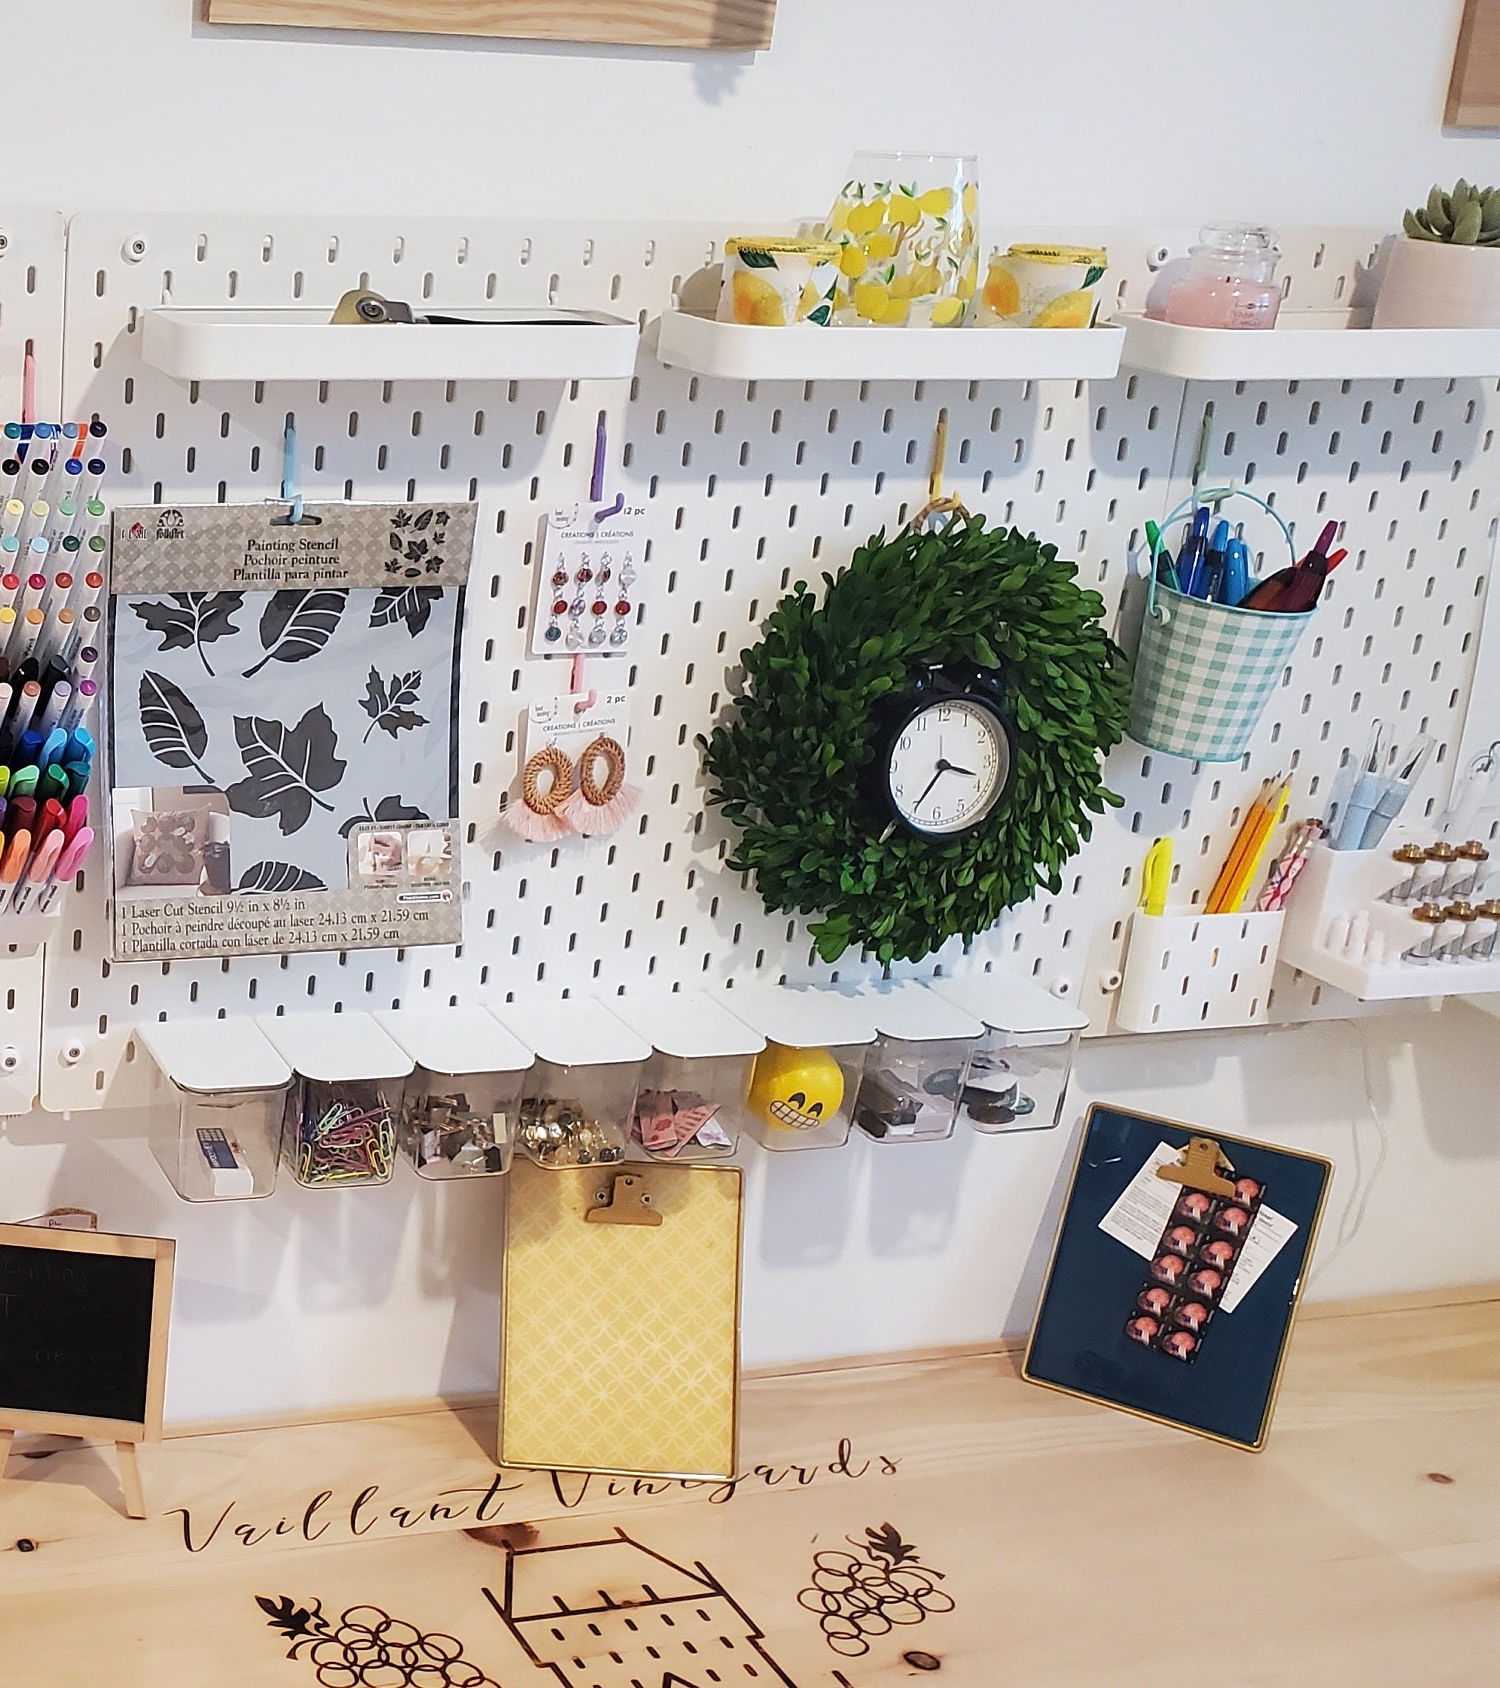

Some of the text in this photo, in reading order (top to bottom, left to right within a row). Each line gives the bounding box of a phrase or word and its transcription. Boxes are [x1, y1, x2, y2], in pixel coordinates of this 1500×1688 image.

[623, 507, 646, 516] 12 pc
[247, 537, 339, 553] Painting Stencil
[244, 554, 340, 567] Pochoir peinture
[233, 568, 348, 582] Plantilla para pintar
[606, 695, 626, 704] 2 pc
[938, 708, 951, 722] 12
[963, 713, 968, 728] 1
[543, 723, 576, 731] CREATIONS
[916, 717, 927, 731] 11
[900, 736, 911, 750] 10
[977, 730, 986, 744] 2
[890, 760, 898, 773] 9
[983, 755, 991, 768] 3
[895, 784, 903, 798] 8
[973, 778, 981, 792] 4
[913, 801, 921, 814] 7
[956, 799, 965, 812] 5
[933, 807, 941, 820] 6
[121, 907, 126, 919] 1
[131, 905, 161, 918] Laser
[164, 903, 184, 917] Cut
[188, 900, 223, 915] Stencil
[248, 900, 259, 912] in
[263, 903, 269, 912] x
[294, 898, 305, 910] in
[121, 909, 429, 936] 1 Pochoir à peindre découpé au laser 24.13 cm x 21.59 cm
[121, 927, 399, 953] 1 Plantilla cortada con láser de 24.13 cm x 21.59 cm
[161, 1473, 524, 1553] Vaillant
